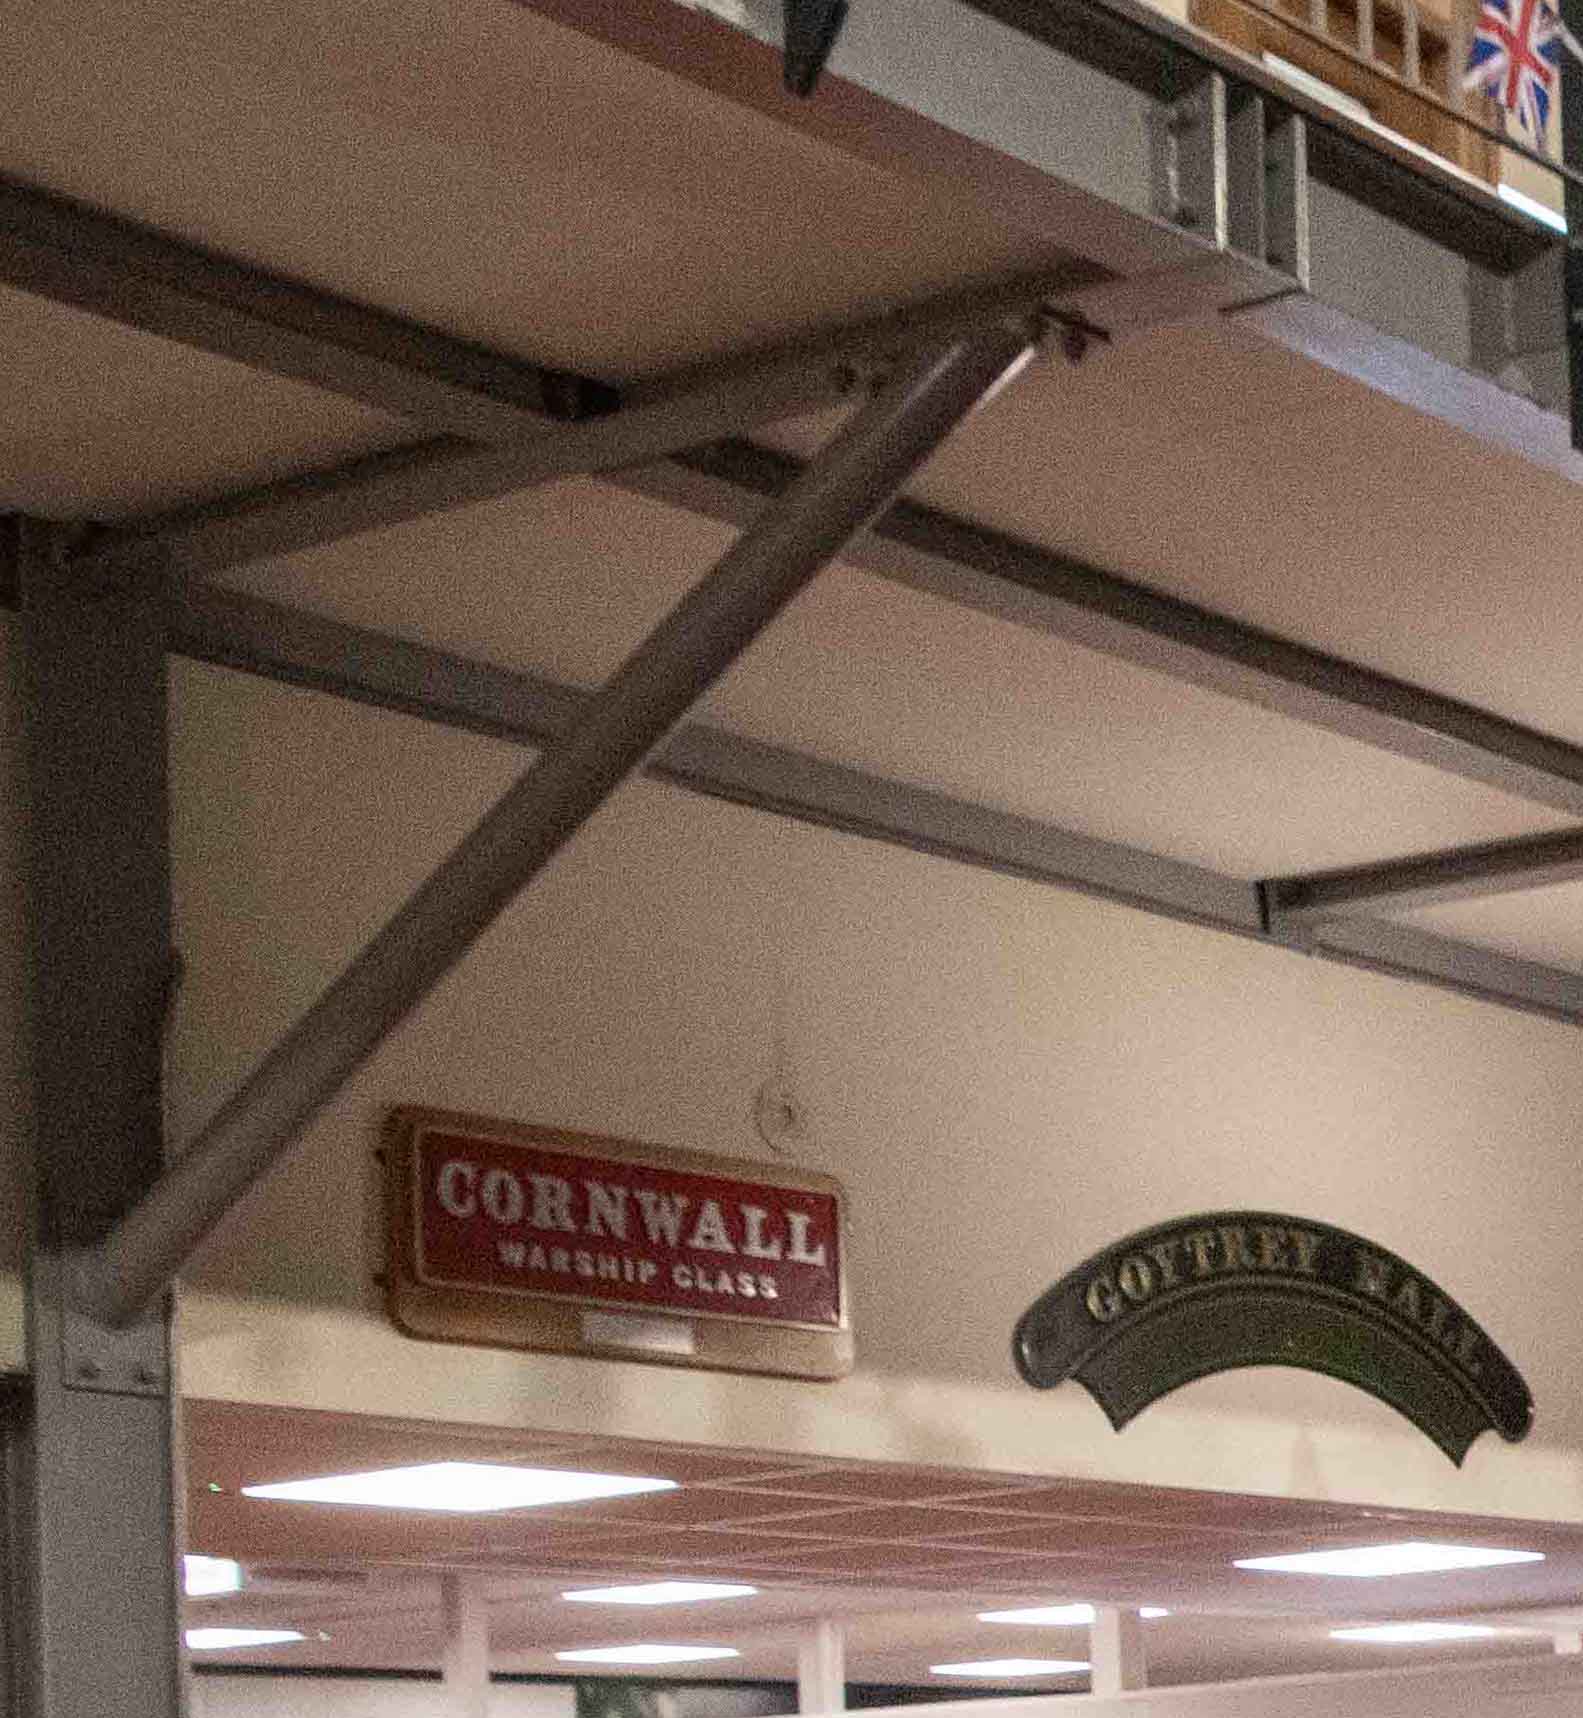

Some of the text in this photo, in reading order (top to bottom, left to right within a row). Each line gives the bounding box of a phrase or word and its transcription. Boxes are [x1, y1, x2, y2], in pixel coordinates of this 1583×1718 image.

[436, 1160, 827, 1268] CORNWALL
[500, 1241, 779, 1301] WARSHIP CLASS
